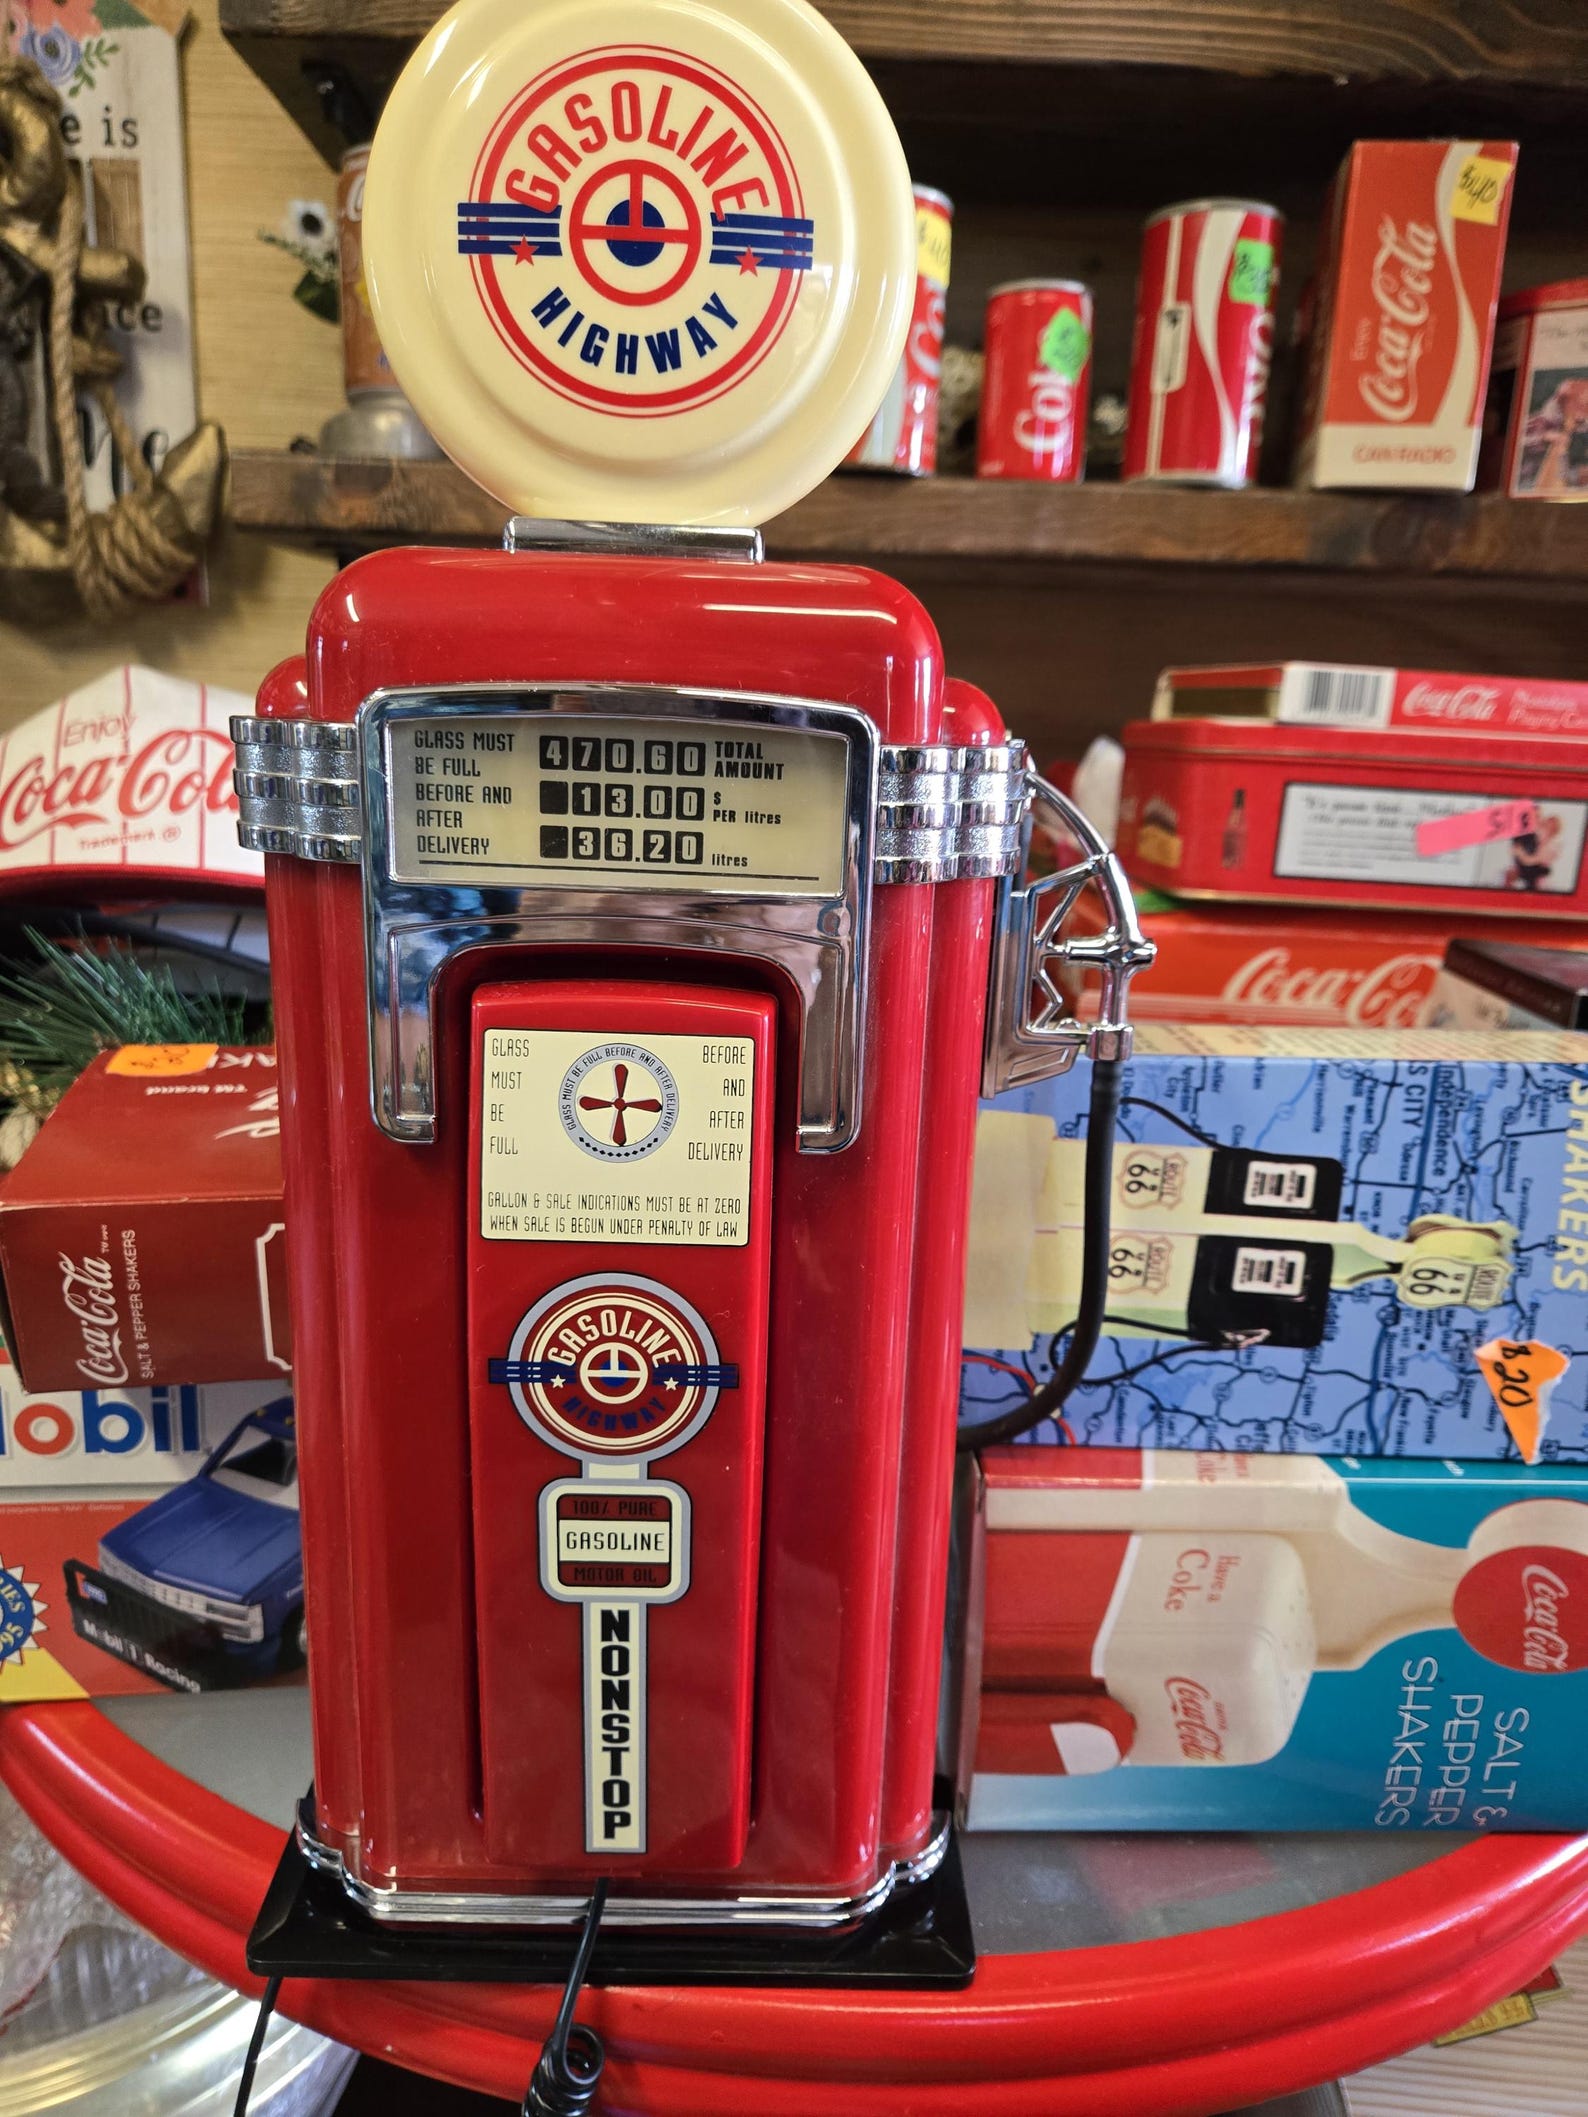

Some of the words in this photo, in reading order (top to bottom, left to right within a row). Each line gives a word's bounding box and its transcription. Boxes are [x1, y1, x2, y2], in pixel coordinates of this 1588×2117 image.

[101, 106, 140, 148] is
[505, 80, 770, 222] GASOLINE
[1358, 213, 1437, 423] Coca-Cola
[530, 286, 739, 376] HIGHWAY
[64, 712, 139, 747] Enjoy
[414, 730, 465, 750] GLASS
[473, 733, 515, 752] MUST
[543, 738, 703, 774] 470.60
[716, 742, 764, 760] TOTAL
[416, 757, 434, 775] BE
[443, 758, 481, 777] FULL
[714, 762, 785, 780] AMOUNT
[0, 729, 240, 851] Coca-Col
[416, 783, 474, 803] BEFORE
[483, 786, 512, 804] AND
[575, 785, 702, 818] 13.00
[713, 790, 722, 806] $
[416, 810, 463, 829] AFTER
[713, 809, 738, 824] PER
[744, 810, 782, 825] litres
[417, 835, 490, 856] DELIVERY
[575, 830, 702, 861] 36.20
[711, 853, 748, 867] litres
[491, 1038, 530, 1057] GLASS
[582, 1053, 603, 1067] FULL
[605, 1046, 636, 1059] BEFORE
[639, 1052, 656, 1067] AND
[702, 1045, 747, 1064] BEFORE
[491, 1071, 522, 1089] MUST
[572, 1066, 584, 1078] BE
[655, 1065, 673, 1090] AFTER
[562, 1078, 576, 1101] MUST
[723, 1078, 745, 1096] AND
[1164, 1077, 1180, 1099] City
[491, 1104, 505, 1122] BE
[562, 1104, 577, 1131] GLASS
[661, 1093, 676, 1132] DELIVERY
[1402, 1084, 1427, 1128] CITY
[709, 1111, 744, 1129] AFTER
[1432, 1065, 1460, 1176] Independence
[490, 1136, 518, 1155] FULL
[688, 1142, 744, 1161] DELIVERY
[1125, 1163, 1152, 1194] 66
[488, 1192, 527, 1208] GALLON
[533, 1193, 540, 1208] &
[546, 1193, 572, 1210] SALE
[577, 1194, 641, 1211] INDICATIONS
[646, 1196, 673, 1212] MUST
[679, 1197, 692, 1213] BE
[697, 1197, 709, 1213] AT
[714, 1198, 741, 1214] ZERO
[490, 1215, 519, 1231] WHEN
[524, 1216, 550, 1232] SALE
[555, 1217, 566, 1233] IS
[571, 1217, 605, 1234] BEGUN
[610, 1218, 643, 1234] UNDER
[649, 1219, 693, 1236] PENALTY
[698, 1220, 712, 1236] OF
[716, 1221, 739, 1237] LAW
[122, 1229, 141, 1291] SHAKERS
[1110, 1248, 1136, 1278] 66
[1409, 1268, 1449, 1295] 66
[1469, 1268, 1498, 1300] ROUTE
[58, 1251, 130, 1385] Coca-Cola
[130, 1293, 149, 1340] PEPPER
[137, 1343, 151, 1351] &
[547, 1309, 682, 1369] GASOLINE
[139, 1354, 155, 1380] SALT
[1493, 1344, 1534, 1407] $20
[562, 1396, 667, 1431] HIGHWAY
[619, 1501, 658, 1516] PURE
[566, 1531, 665, 1551] GASOLINE
[574, 1567, 624, 1581] MOTOR
[633, 1568, 657, 1582] OIL
[1163, 1549, 1212, 1612] Coke
[1211, 1555, 1242, 1591] Have
[1207, 1593, 1222, 1604] a
[1522, 1564, 1569, 1672] Coca-Cola
[600, 1608, 632, 1840] NONSTOP
[1164, 1677, 1226, 1762] Coca-Cola
[1374, 1656, 1439, 1826] SHAKERS
[1481, 1707, 1530, 1800] SALT
[1422, 1694, 1485, 1826] PEPPER
[1472, 1806, 1508, 1827] &
